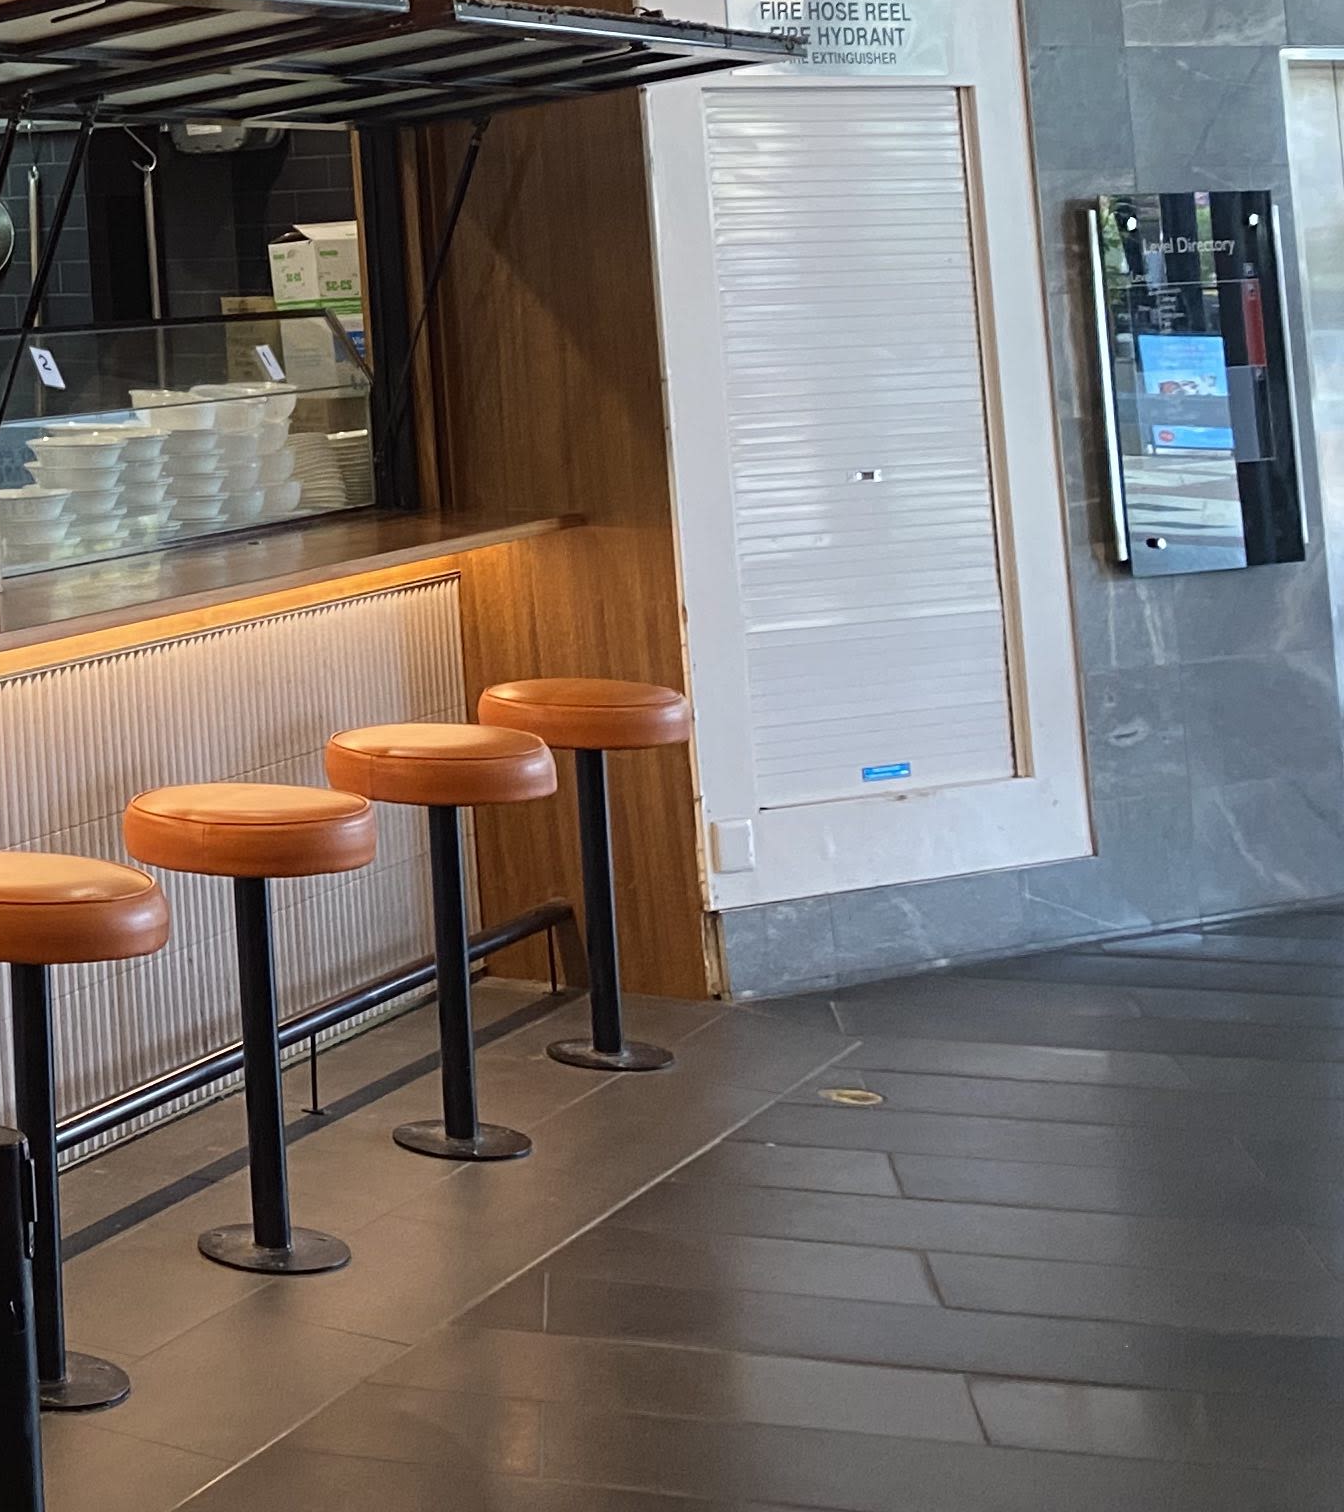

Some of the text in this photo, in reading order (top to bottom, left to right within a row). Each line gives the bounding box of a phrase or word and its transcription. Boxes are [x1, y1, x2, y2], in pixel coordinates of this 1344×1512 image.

[760, 1, 911, 21] FIRE HOSE REEL
[817, 27, 905, 46] HYDRANT
[812, 52, 897, 65] EXTINGUISHER
[1143, 237, 1235, 256] Level Directory
[37, 353, 52, 371] 2
